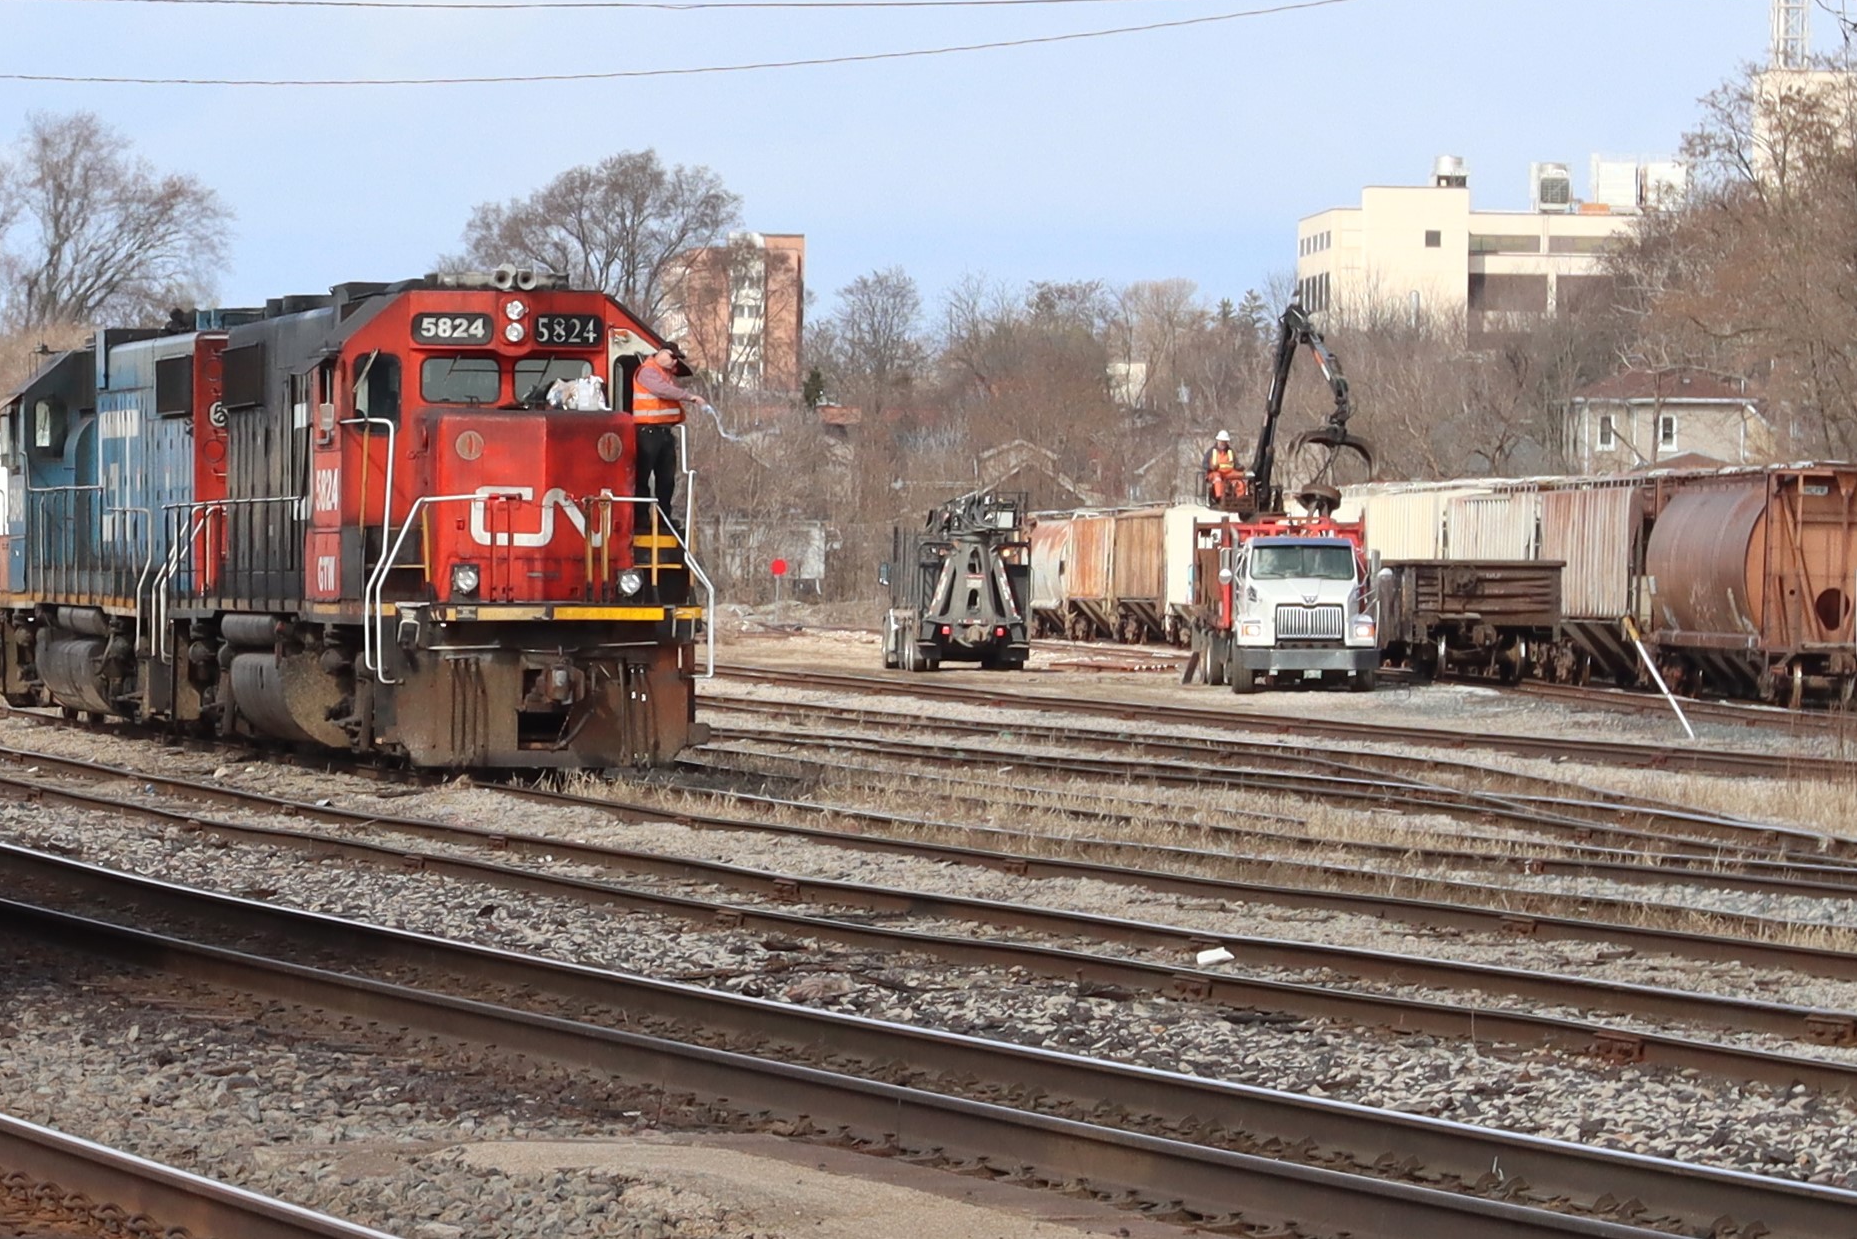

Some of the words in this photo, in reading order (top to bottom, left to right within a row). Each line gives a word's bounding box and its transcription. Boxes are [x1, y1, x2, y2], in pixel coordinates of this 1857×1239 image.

[420, 317, 486, 339] 5824
[536, 317, 598, 343] 5824
[316, 468, 339, 511] 5824
[471, 485, 612, 548] CN
[317, 555, 336, 592] GTW
